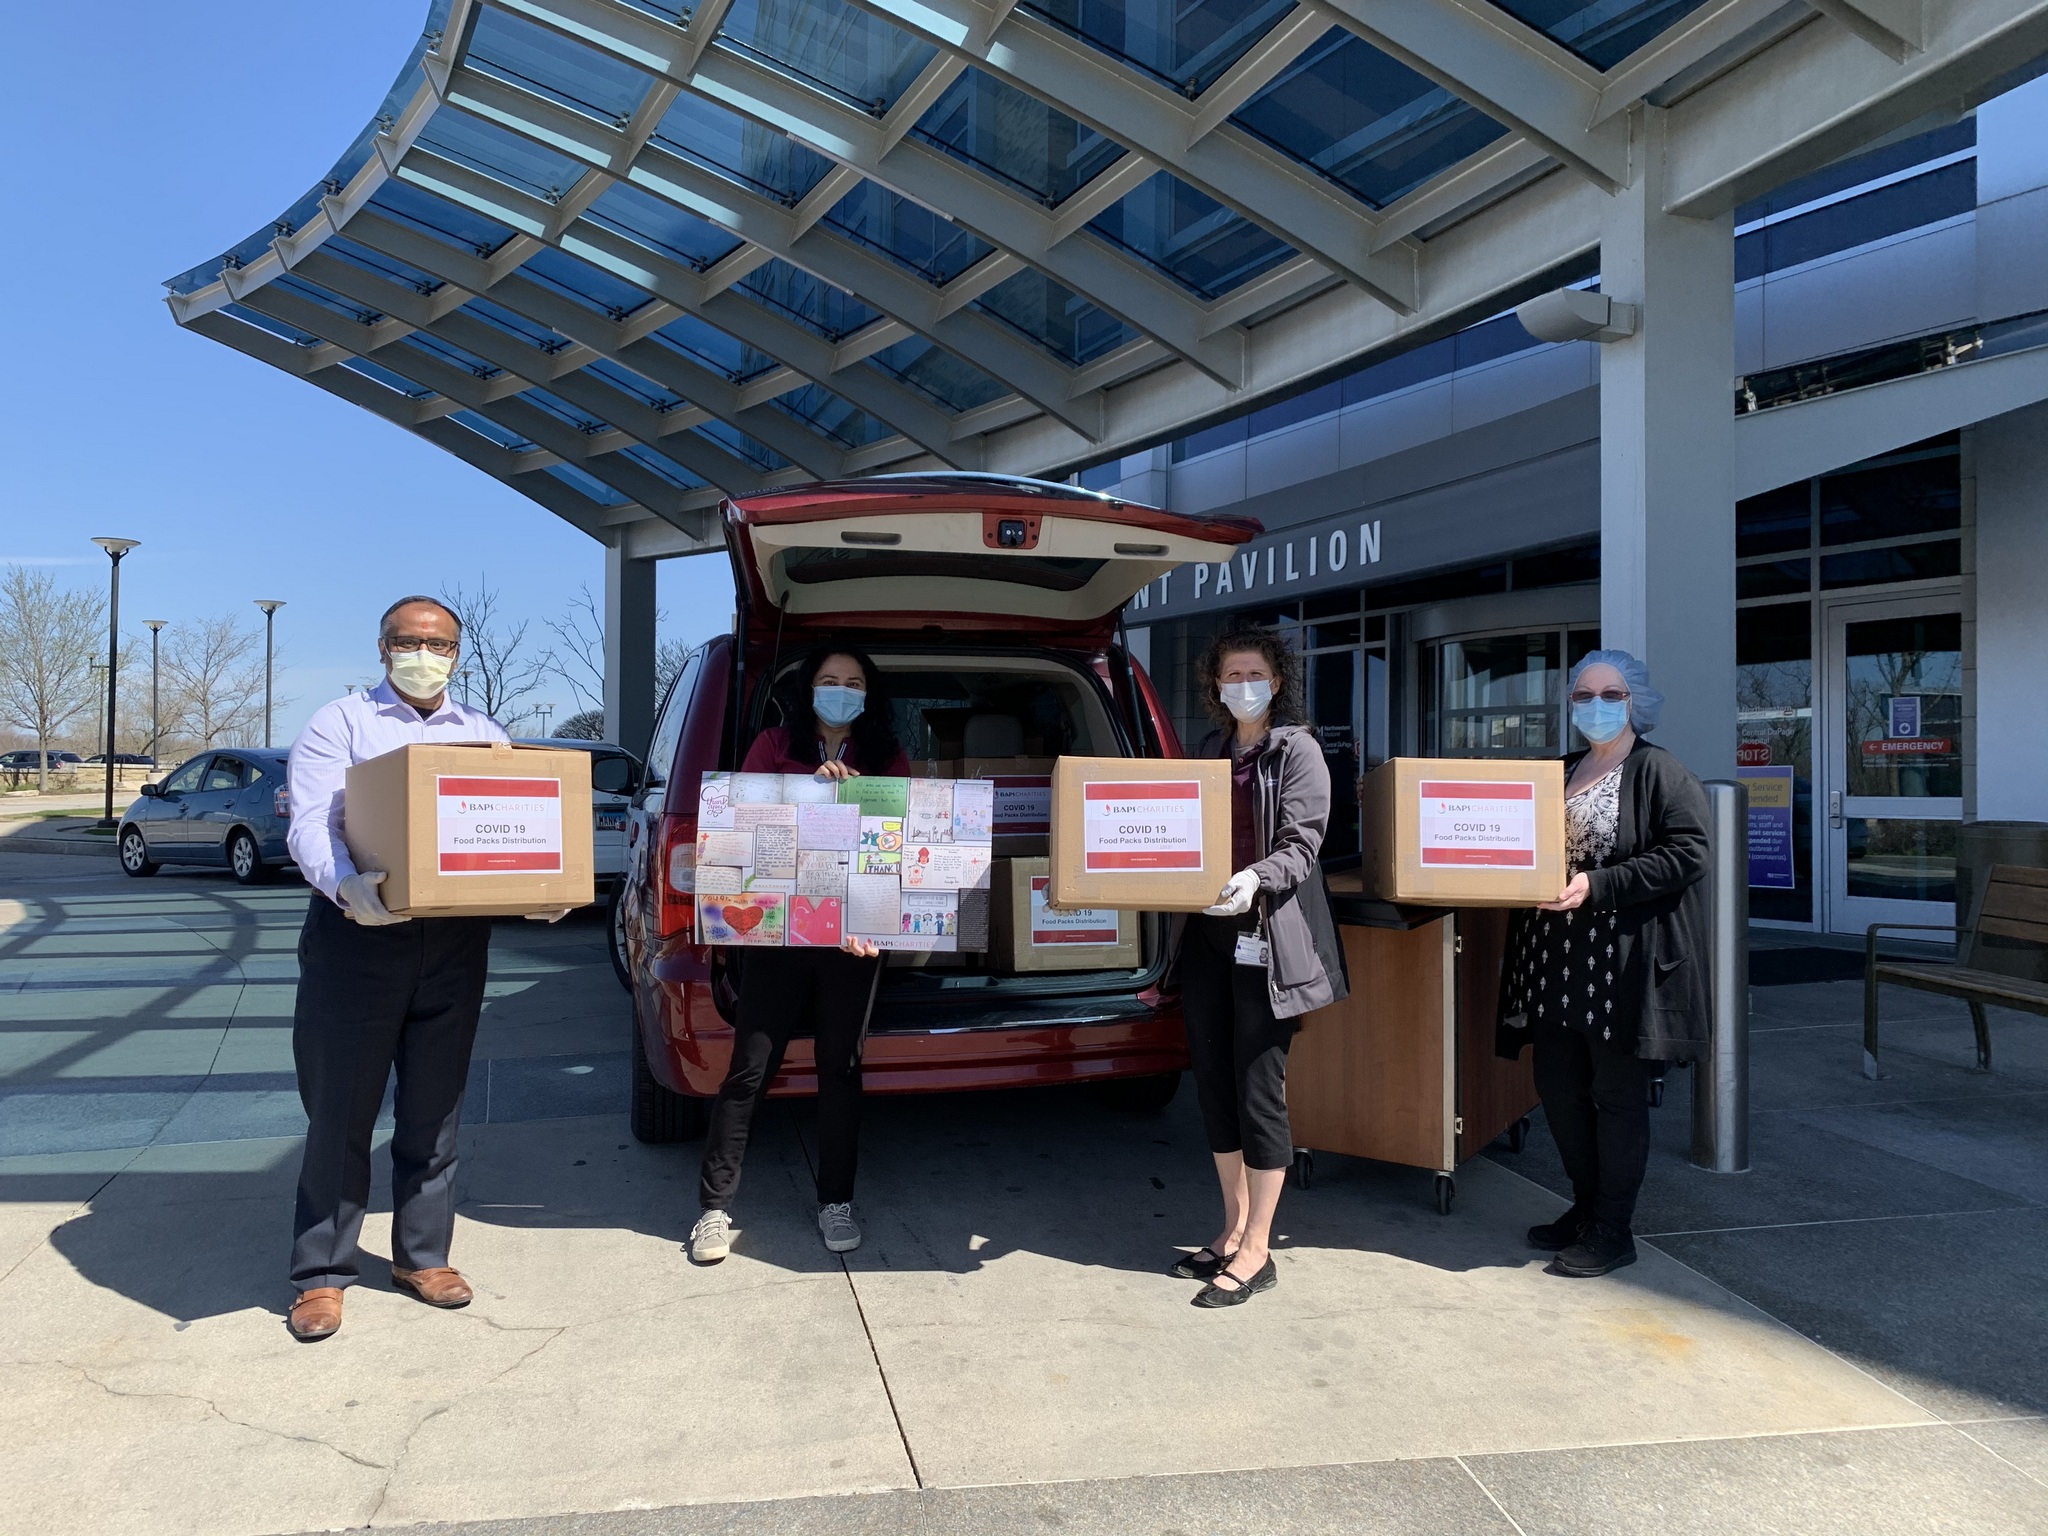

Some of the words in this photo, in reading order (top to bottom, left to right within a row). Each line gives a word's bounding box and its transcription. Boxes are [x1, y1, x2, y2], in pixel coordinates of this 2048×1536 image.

[1194, 520, 1381, 599] PAVILION
[1741, 728, 1766, 736] Central
[1767, 727, 1795, 736] DuPage
[1741, 737, 1769, 745] Hospital
[1881, 741, 1944, 751] EMERGENCY
[1752, 782, 1783, 792] Service
[1748, 795, 1778, 803] pended
[469, 803, 494, 811] BAPS
[494, 803, 545, 812] CHARITIES
[1137, 805, 1185, 813] CHARITIES
[1448, 804, 1471, 812] BAPS
[1471, 804, 1519, 813] CHARITIES
[475, 824, 511, 834] COVID
[513, 824, 526, 834] 19
[1118, 825, 1152, 834] COVID
[1155, 825, 1167, 834] 19
[1453, 823, 1486, 832] COVID
[1489, 824, 1501, 833] 19
[453, 837, 475, 845] Food
[476, 837, 500, 845] Packs
[502, 837, 547, 845] Distribution
[1099, 837, 1118, 845] Food
[1119, 837, 1142, 845] Packs
[1143, 836, 1187, 844] Distribution
[1454, 834, 1477, 842] Packs
[1478, 834, 1521, 842] Distribution
[868, 864, 894, 873] THANK
[895, 863, 901, 872] U
[893, 940, 935, 948] CHARITIES
